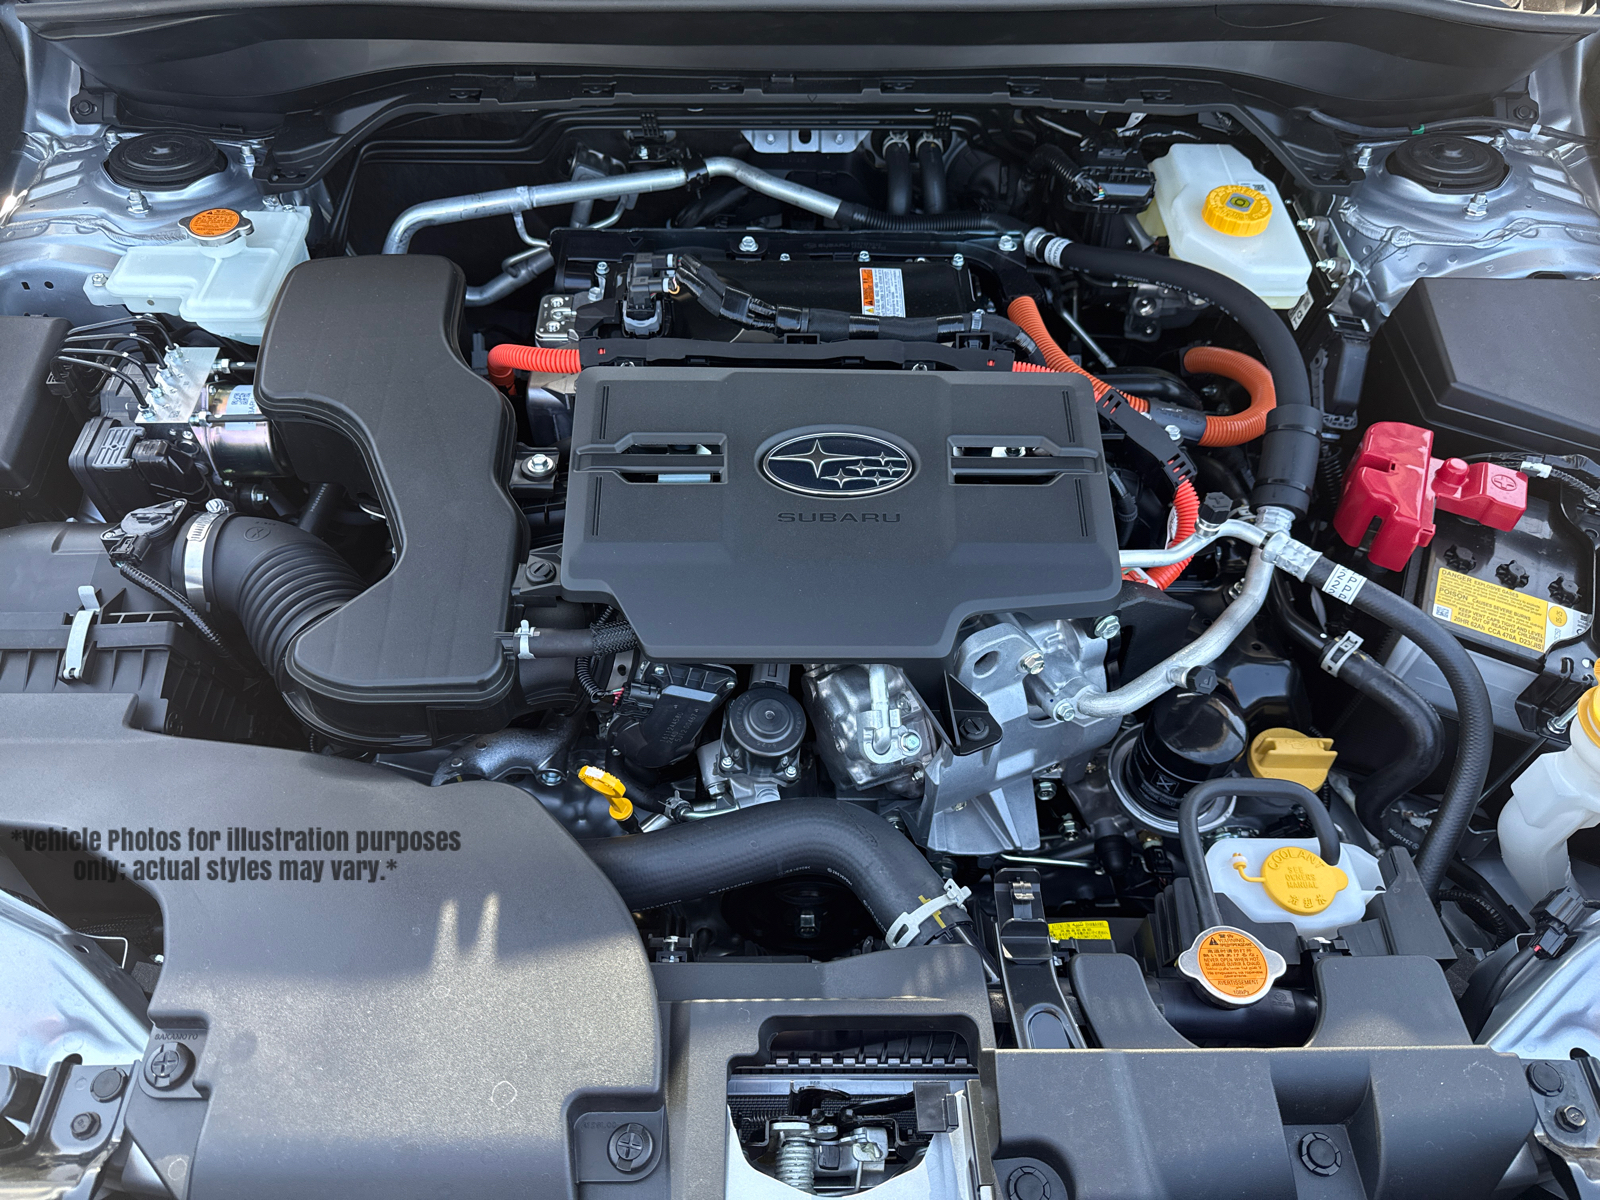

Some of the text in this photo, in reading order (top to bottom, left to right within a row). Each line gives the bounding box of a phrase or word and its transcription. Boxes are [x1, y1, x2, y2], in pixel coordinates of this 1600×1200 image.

[777, 512, 900, 523] SUBARU
[1441, 569, 1472, 583] DANGER
[1438, 587, 1468, 600] POISON
[1487, 626, 1502, 635] CCA
[1501, 631, 1517, 641] 470A
[1516, 630, 1543, 643] CHILDREN
[1527, 629, 1544, 638] LEVEL
[1267, 849, 1325, 870] COOLANT
[1287, 866, 1303, 874] SEE
[1286, 881, 1319, 889] MANUAL
